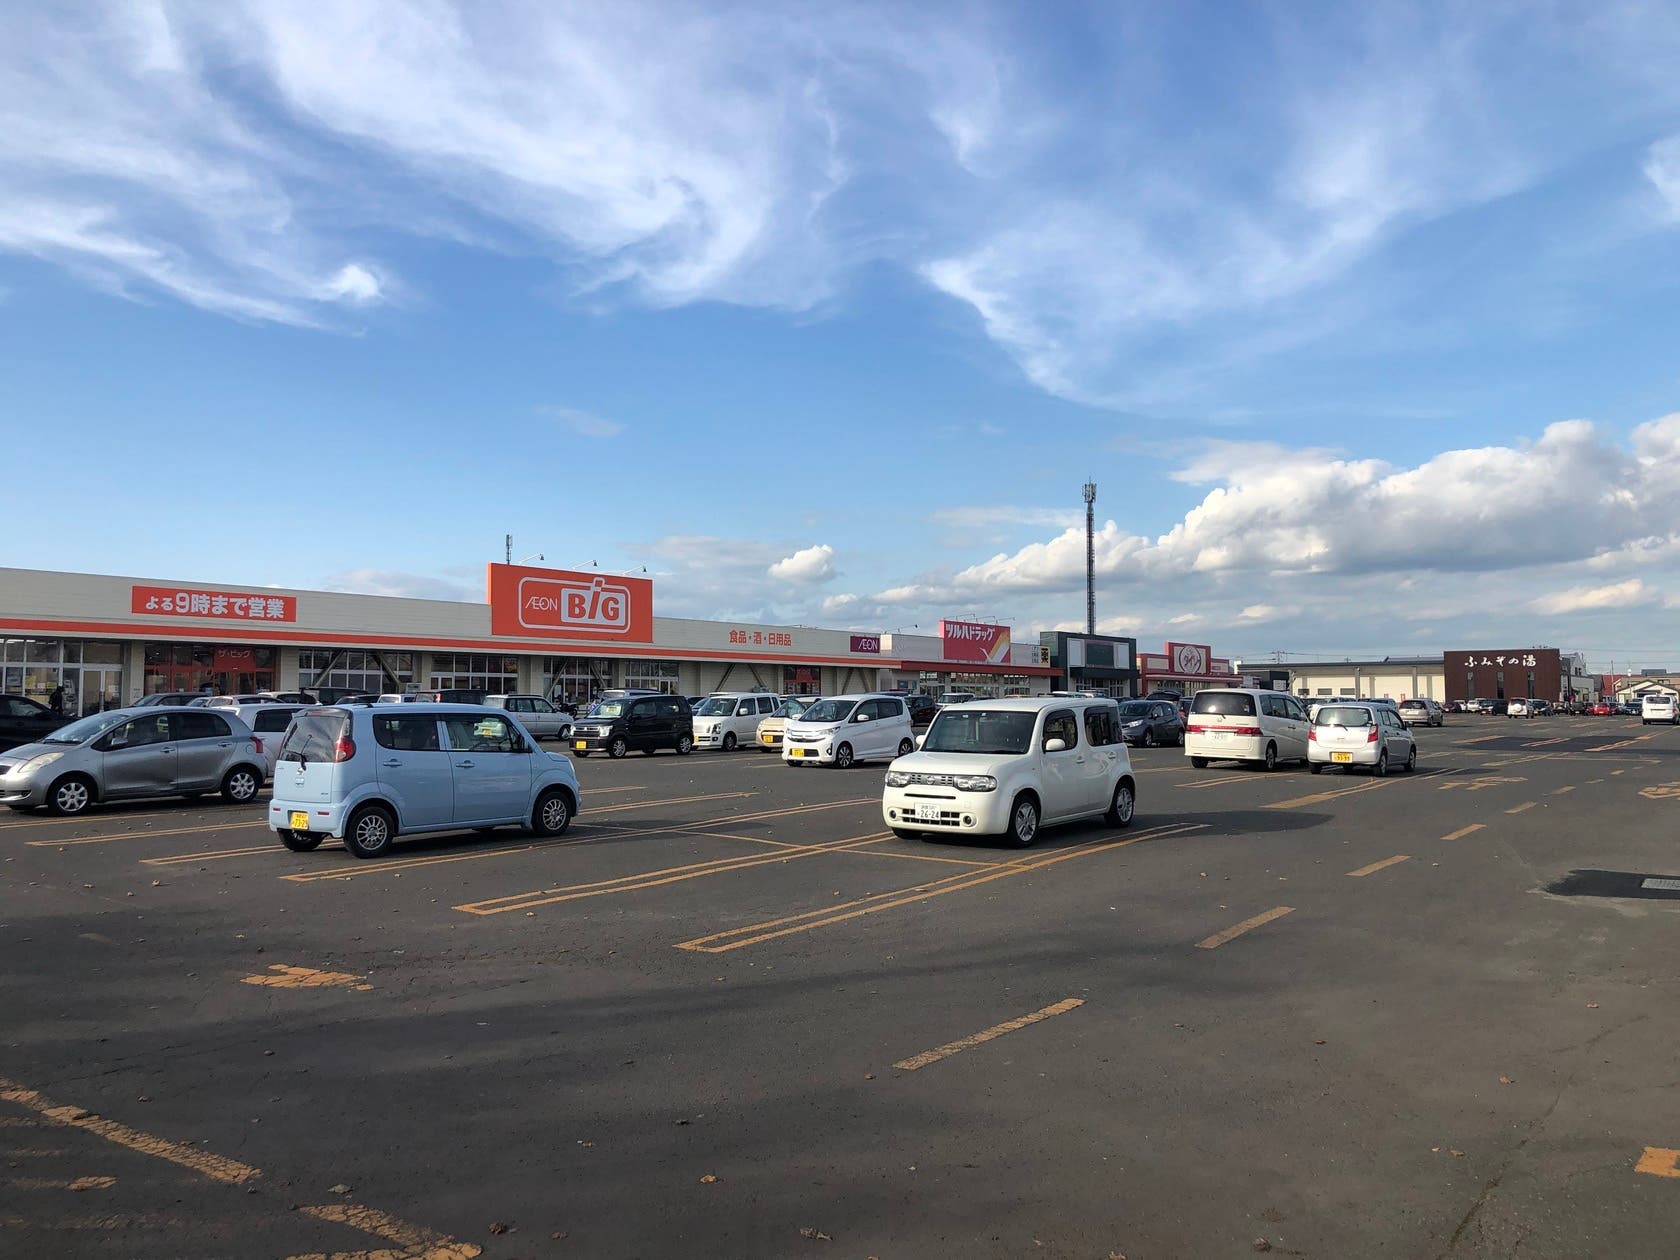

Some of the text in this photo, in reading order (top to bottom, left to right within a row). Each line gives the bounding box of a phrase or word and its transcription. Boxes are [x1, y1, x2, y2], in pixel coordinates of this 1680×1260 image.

[145, 592, 285, 619] よる9時まで営業
[945, 623, 996, 641] ツルハドラッグ
[920, 809, 939, 819] 26-24
